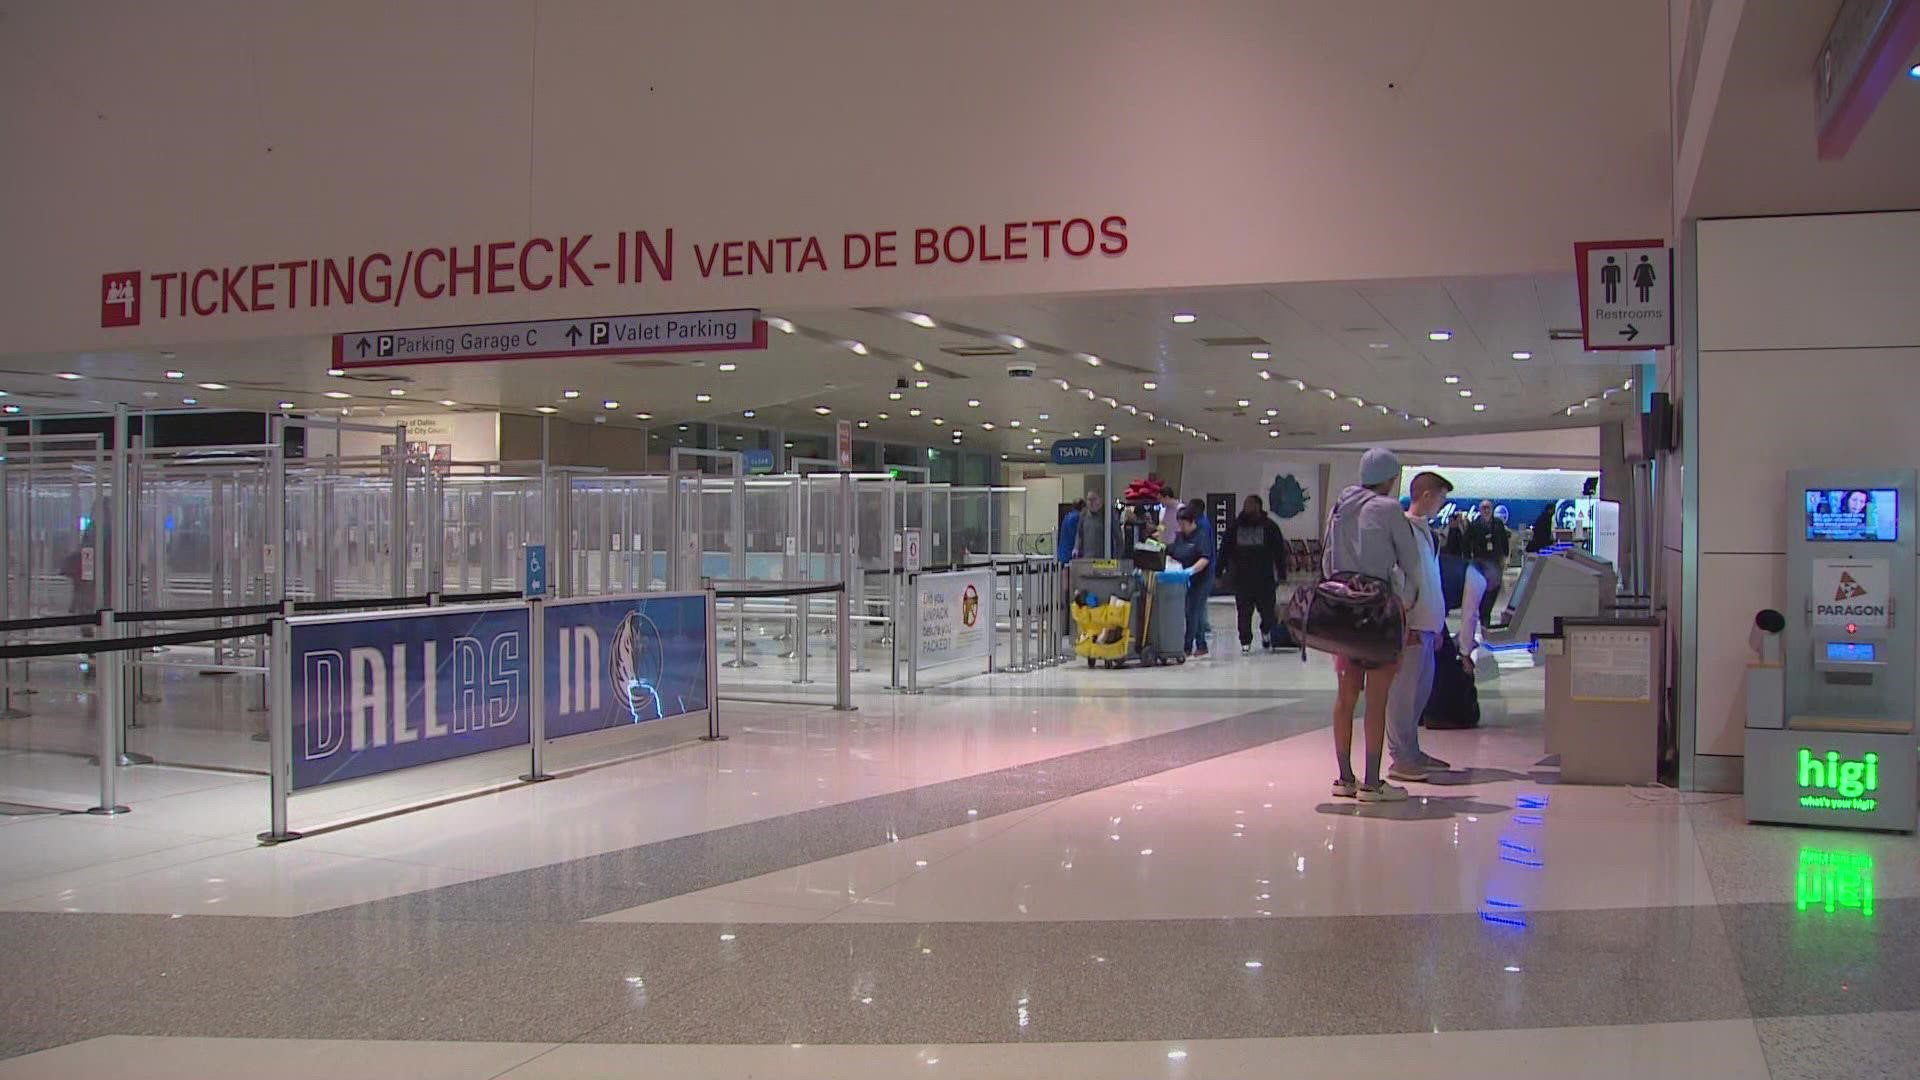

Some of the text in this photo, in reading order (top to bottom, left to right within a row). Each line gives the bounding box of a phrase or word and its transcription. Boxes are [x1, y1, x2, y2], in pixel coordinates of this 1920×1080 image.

[151, 215, 1129, 318] TICKETING/CHECK-IN VENTA DE BOLETOS
[1595, 308, 1664, 320] Restrooms
[397, 335, 455, 354] Parking
[460, 332, 521, 351] Garage
[526, 329, 538, 346] C
[614, 322, 661, 341] Valet
[666, 319, 737, 340] Parking
[414, 426, 427, 436] City
[1059, 446, 1074, 457] TSA
[1816, 605, 1885, 617] PARAGON
[558, 625, 600, 716] IN
[303, 631, 521, 761] DALLAS
[1799, 748, 1877, 798] higi
